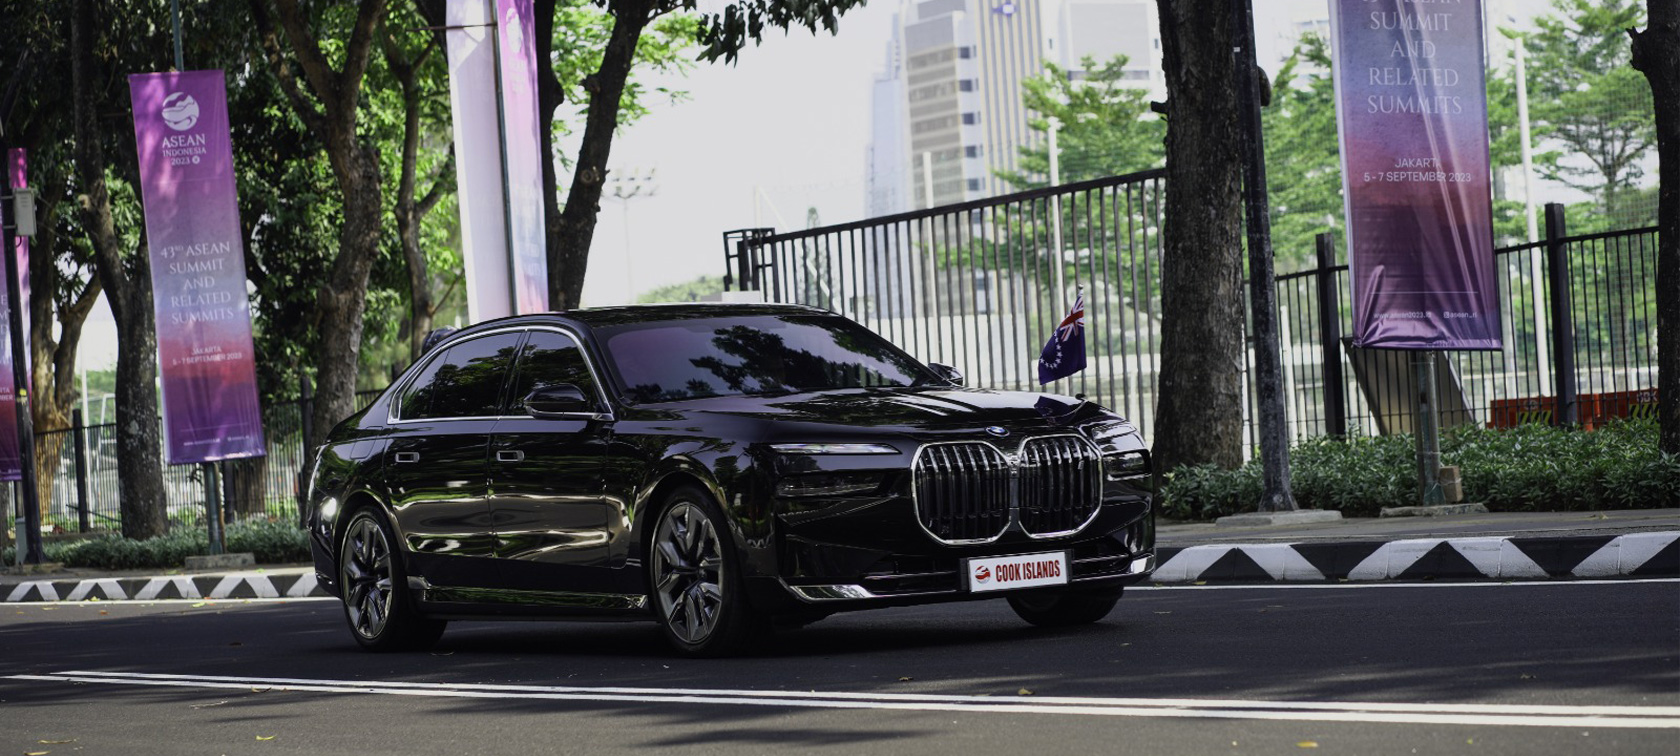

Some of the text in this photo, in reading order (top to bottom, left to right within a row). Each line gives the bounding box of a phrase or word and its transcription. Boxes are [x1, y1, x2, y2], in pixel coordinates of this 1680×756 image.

[1370, 11, 1452, 31] SUMMIT
[1390, 40, 1436, 59] AND
[1369, 67, 1459, 87] RELATED
[1367, 94, 1462, 114] SUMMITS
[162, 133, 206, 149] ASEAN
[163, 146, 207, 157] INDONESIA
[171, 156, 191, 166] 2023
[1364, 173, 1371, 182] 5
[1378, 172, 1384, 182] 7
[1386, 171, 1446, 182] SEPTEMBER
[1448, 172, 1472, 182] 2023
[186, 241, 231, 257] ASEAN
[169, 257, 225, 275] SUMMIT
[183, 276, 216, 290] AND
[171, 291, 232, 308] RELATED
[171, 307, 234, 325] SUMMITS
[995, 560, 1061, 582] COOK ISLANDS
